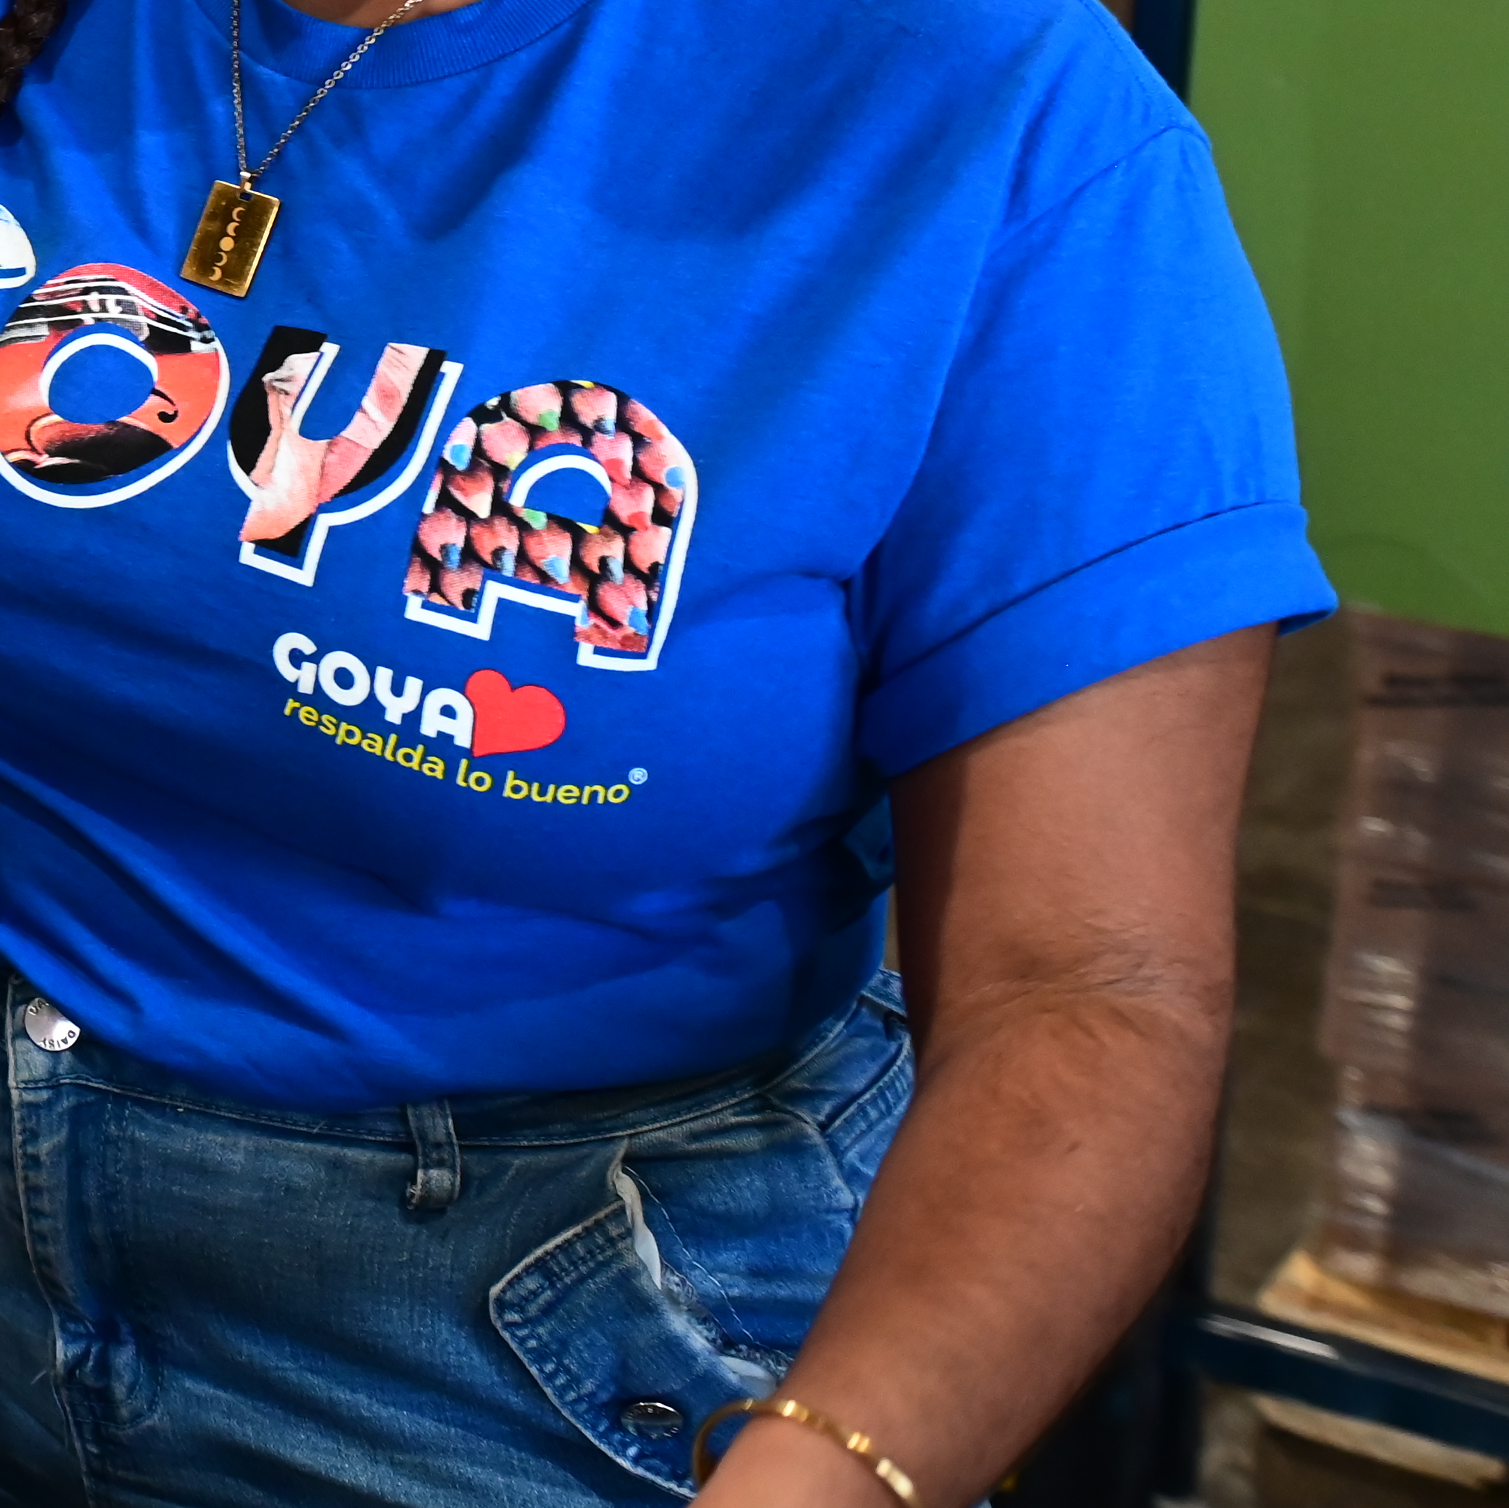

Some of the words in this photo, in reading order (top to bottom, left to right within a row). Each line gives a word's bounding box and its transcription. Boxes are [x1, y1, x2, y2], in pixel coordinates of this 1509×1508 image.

[272, 631, 476, 750] GOYA
[283, 697, 446, 781] respalda
[456, 757, 493, 793] lo
[502, 769, 631, 805] bueno
[41, 1029, 77, 1050] DAISY
